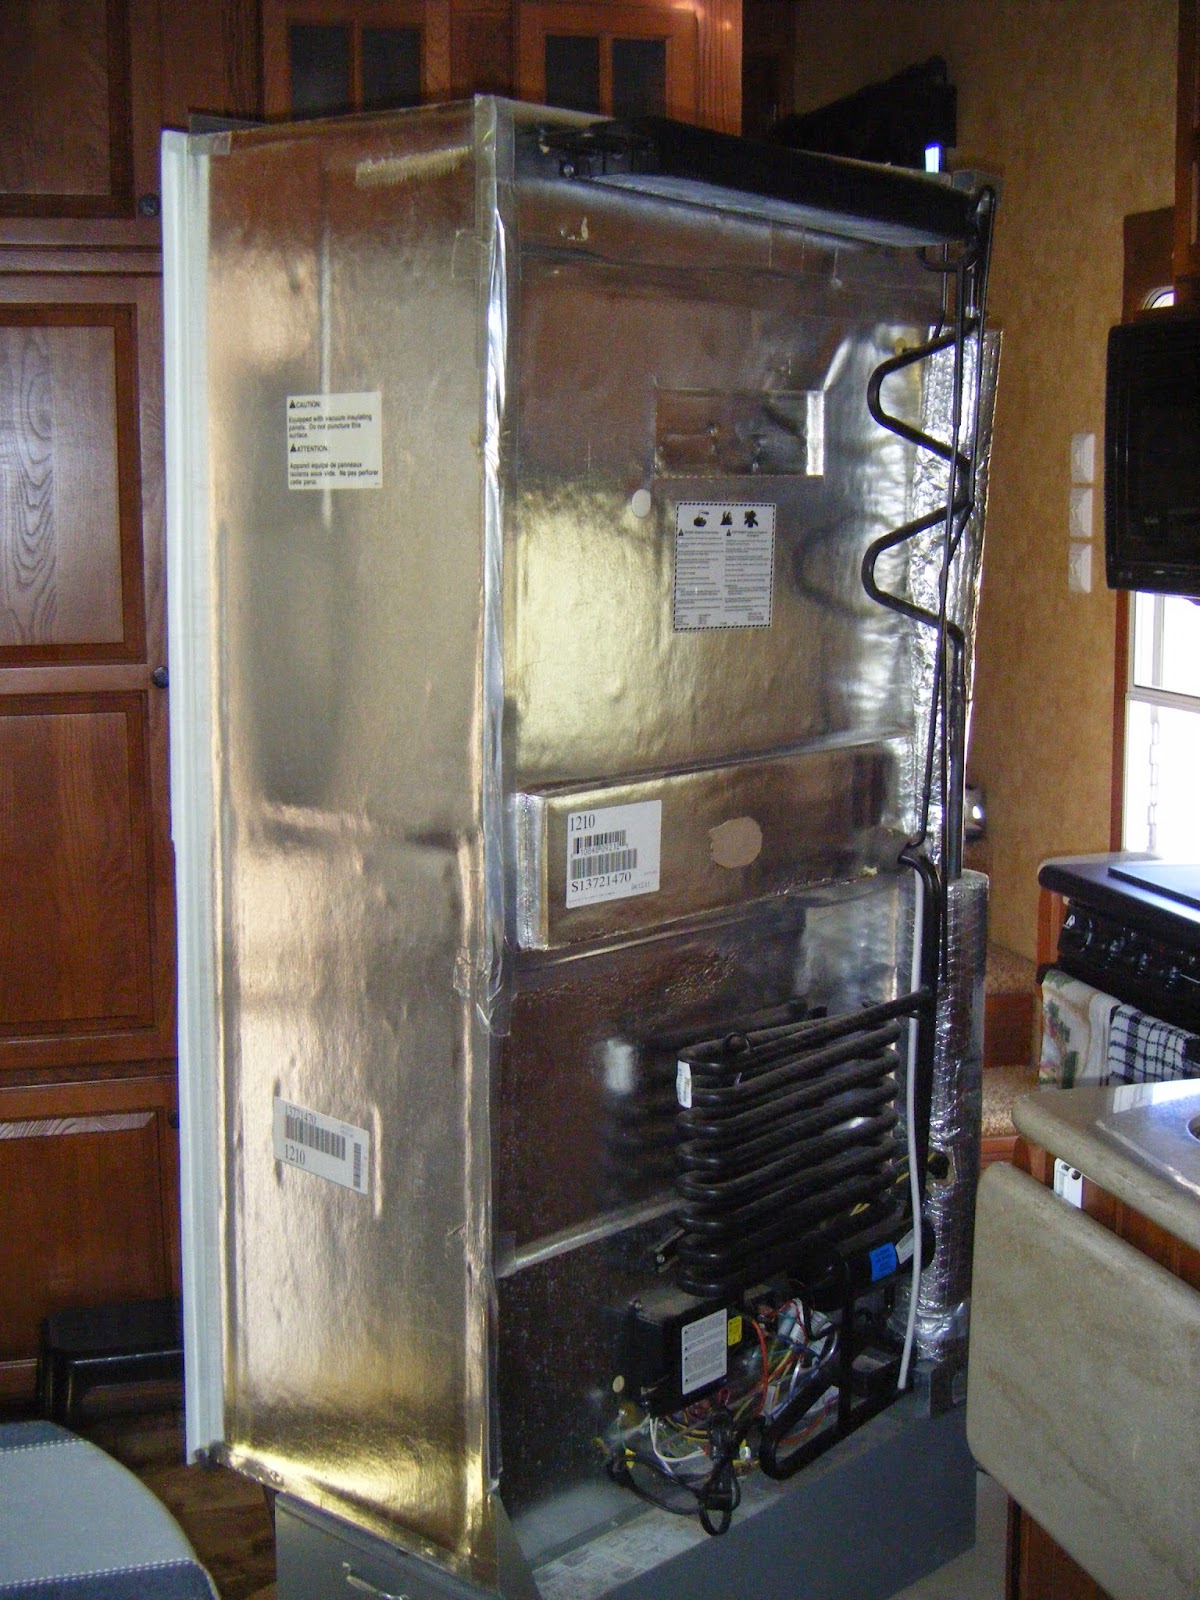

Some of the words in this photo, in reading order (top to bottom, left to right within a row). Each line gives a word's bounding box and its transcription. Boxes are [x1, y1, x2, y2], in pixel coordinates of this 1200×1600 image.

[570, 813, 596, 832] 1210
[571, 871, 632, 893] S13721470
[285, 1143, 306, 1165] 1210
